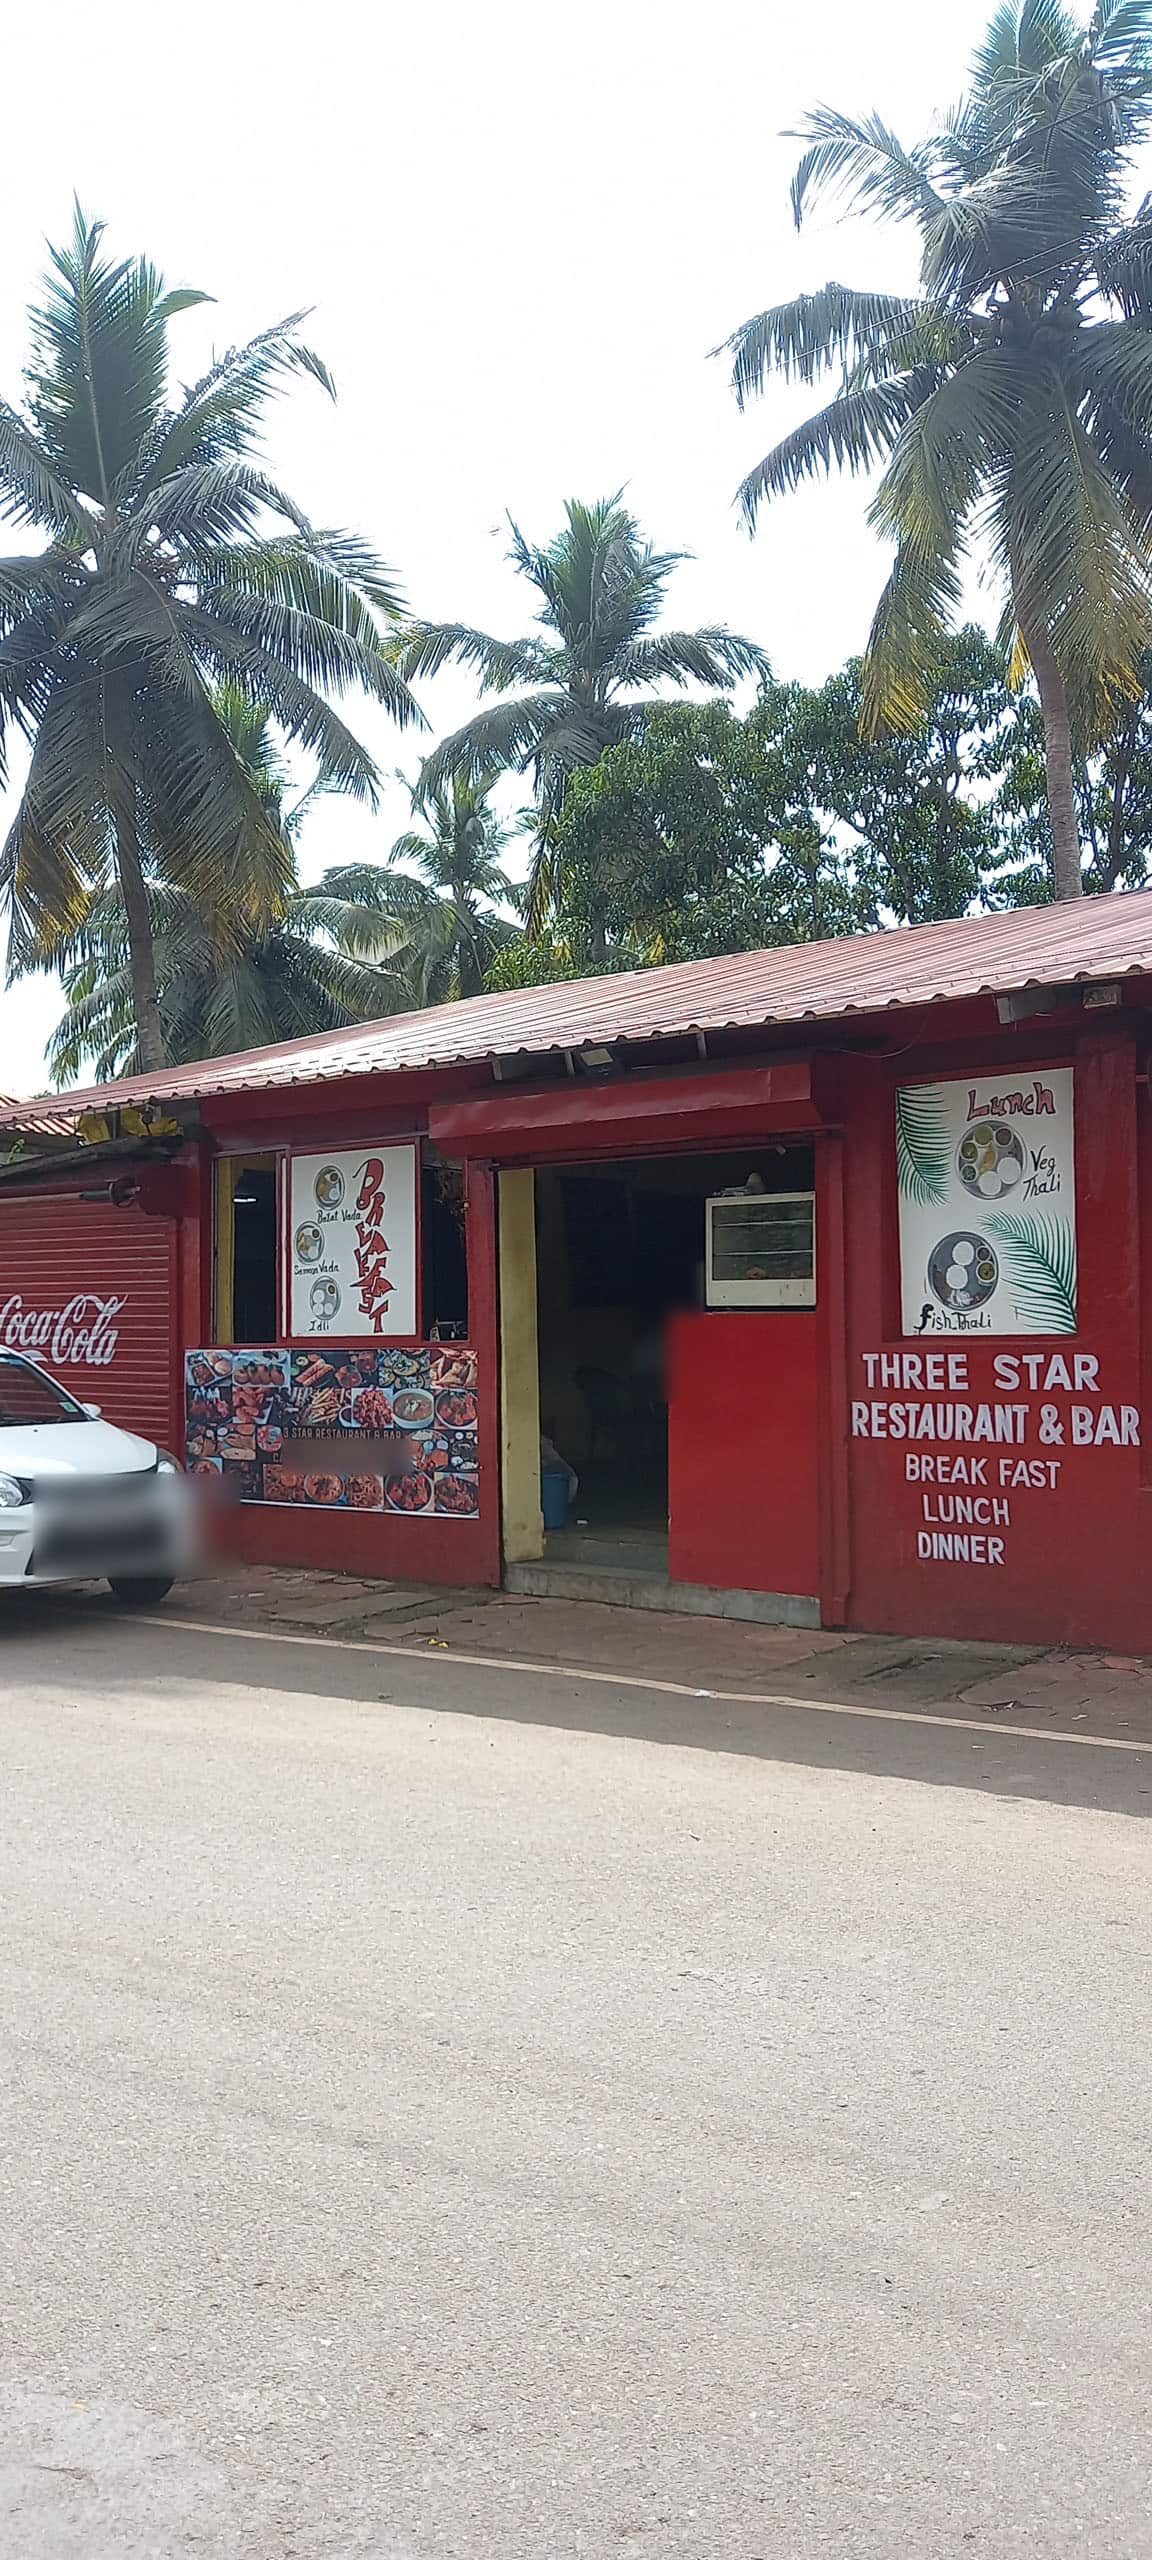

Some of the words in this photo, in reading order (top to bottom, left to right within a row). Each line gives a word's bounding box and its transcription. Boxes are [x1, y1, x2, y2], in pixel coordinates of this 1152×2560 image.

[966, 1082, 1056, 1122] Lunch
[1030, 1145, 1056, 1172] Veg
[1023, 1174, 1061, 1202] Thali
[341, 1209, 362, 1222] Vada
[318, 1260, 340, 1273] Vada
[951, 1311, 991, 1331] Thali
[862, 1353, 969, 1391] THREE
[993, 1353, 1101, 1392] STAR
[291, 1427, 313, 1439] STAR
[315, 1428, 372, 1440] RESTAURANT
[851, 1401, 1029, 1444] RESTAURANT
[1038, 1404, 1065, 1445] &
[1071, 1405, 1141, 1446] BAR
[905, 1453, 988, 1486] BREAK
[999, 1459, 1061, 1489] FAST
[922, 1494, 1010, 1526] LUNCH
[917, 1531, 1005, 1565] DINNER
